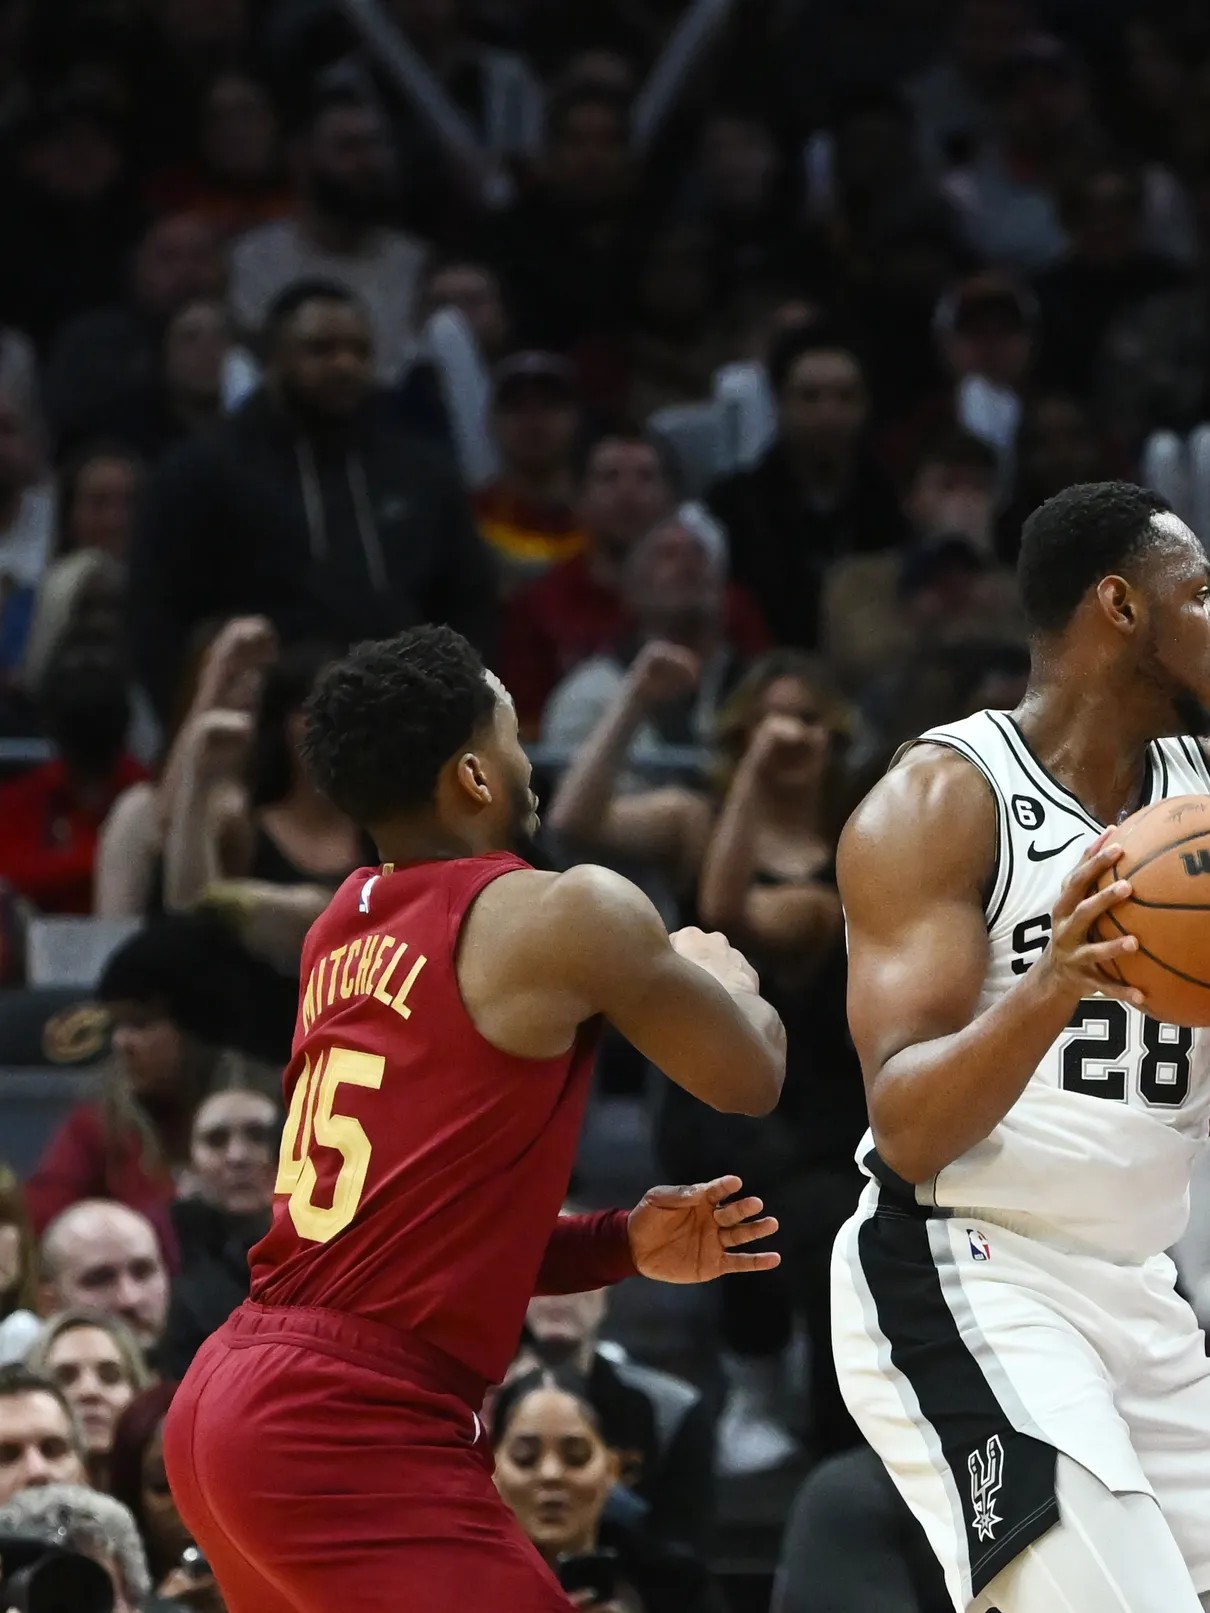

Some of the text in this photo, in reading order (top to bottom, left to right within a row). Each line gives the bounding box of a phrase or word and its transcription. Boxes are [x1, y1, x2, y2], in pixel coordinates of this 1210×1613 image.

[1014, 799, 1038, 827] 6
[303, 934, 427, 1037] MITCHELL
[1058, 997, 1195, 1109] 28
[274, 1046, 386, 1243] 45
